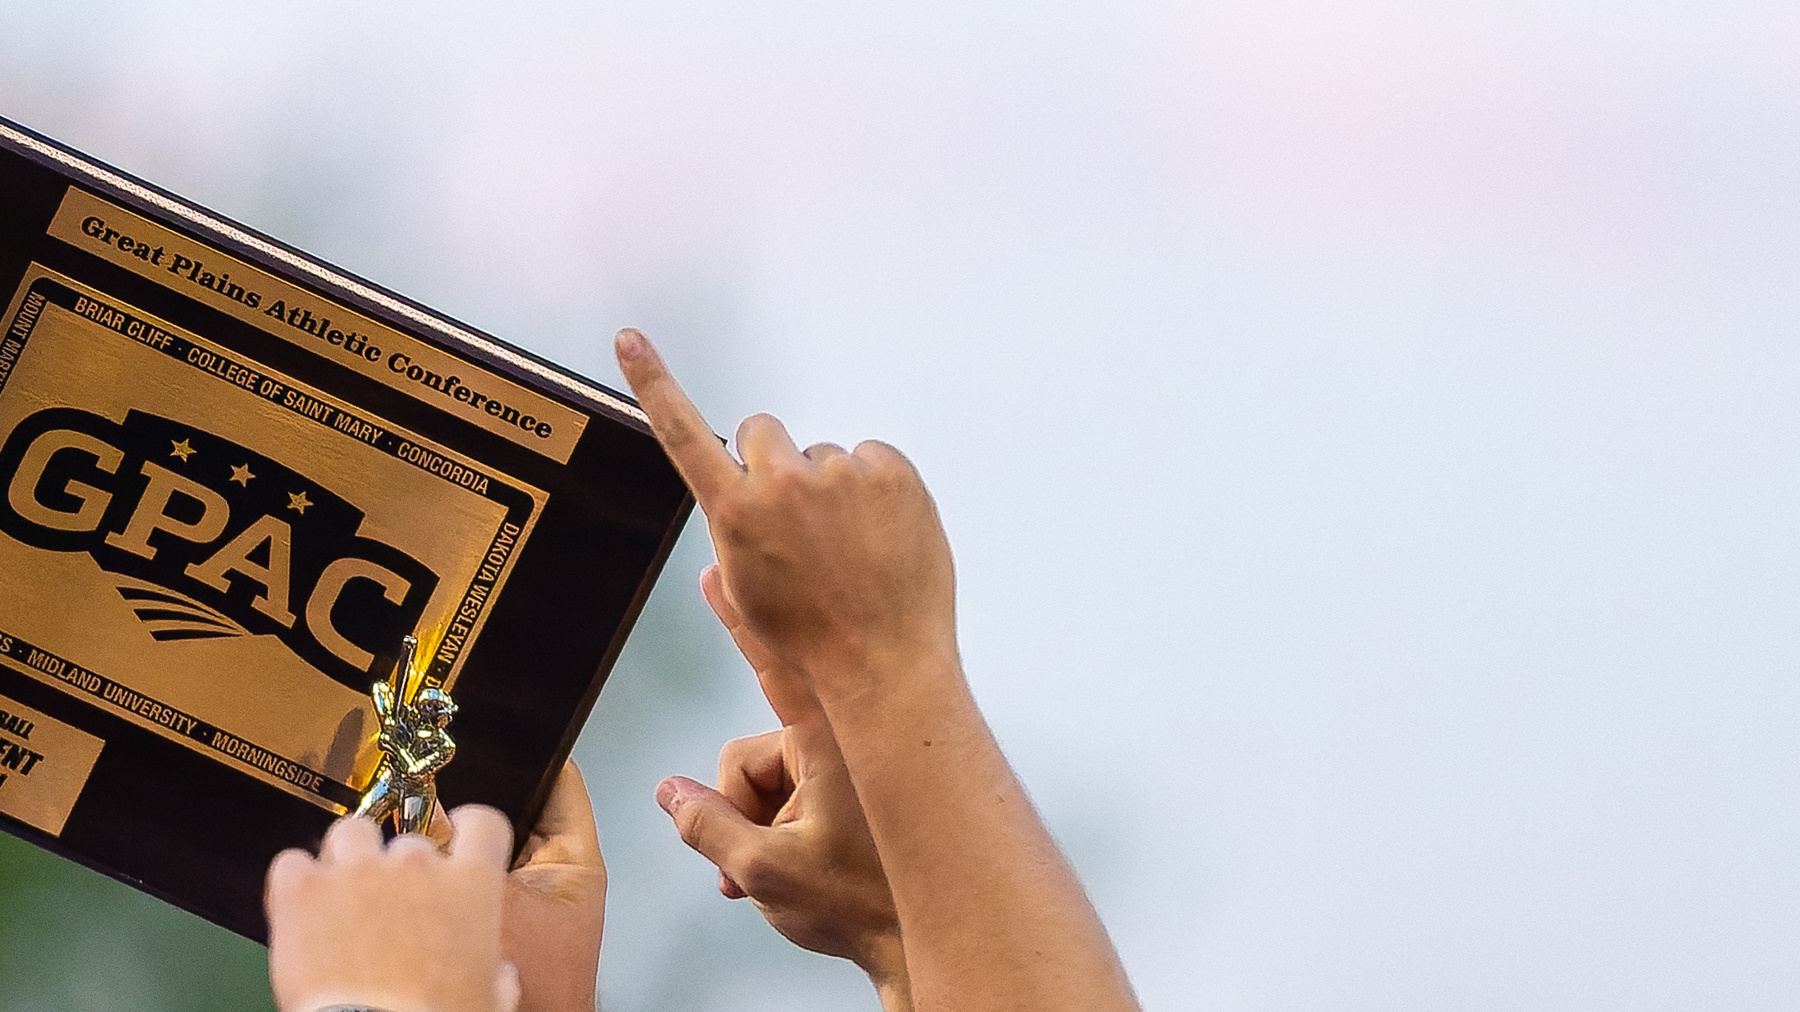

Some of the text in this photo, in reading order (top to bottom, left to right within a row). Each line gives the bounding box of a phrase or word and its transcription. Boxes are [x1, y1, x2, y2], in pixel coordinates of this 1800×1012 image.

[13, 290, 46, 340] MOUNT
[74, 297, 491, 495] BRIAR CLIFF COLLEGE OF SAINT MARY CONCORDIA
[80, 215, 553, 439] Great Plains Athletic Conference
[7, 428, 413, 674] GPAC
[437, 521, 520, 665] DAKOTA WESLEYAN
[26, 648, 101, 693] MIDLAND
[103, 682, 198, 736] UNIVERSITY
[211, 731, 325, 793] MORNINGSIDE
